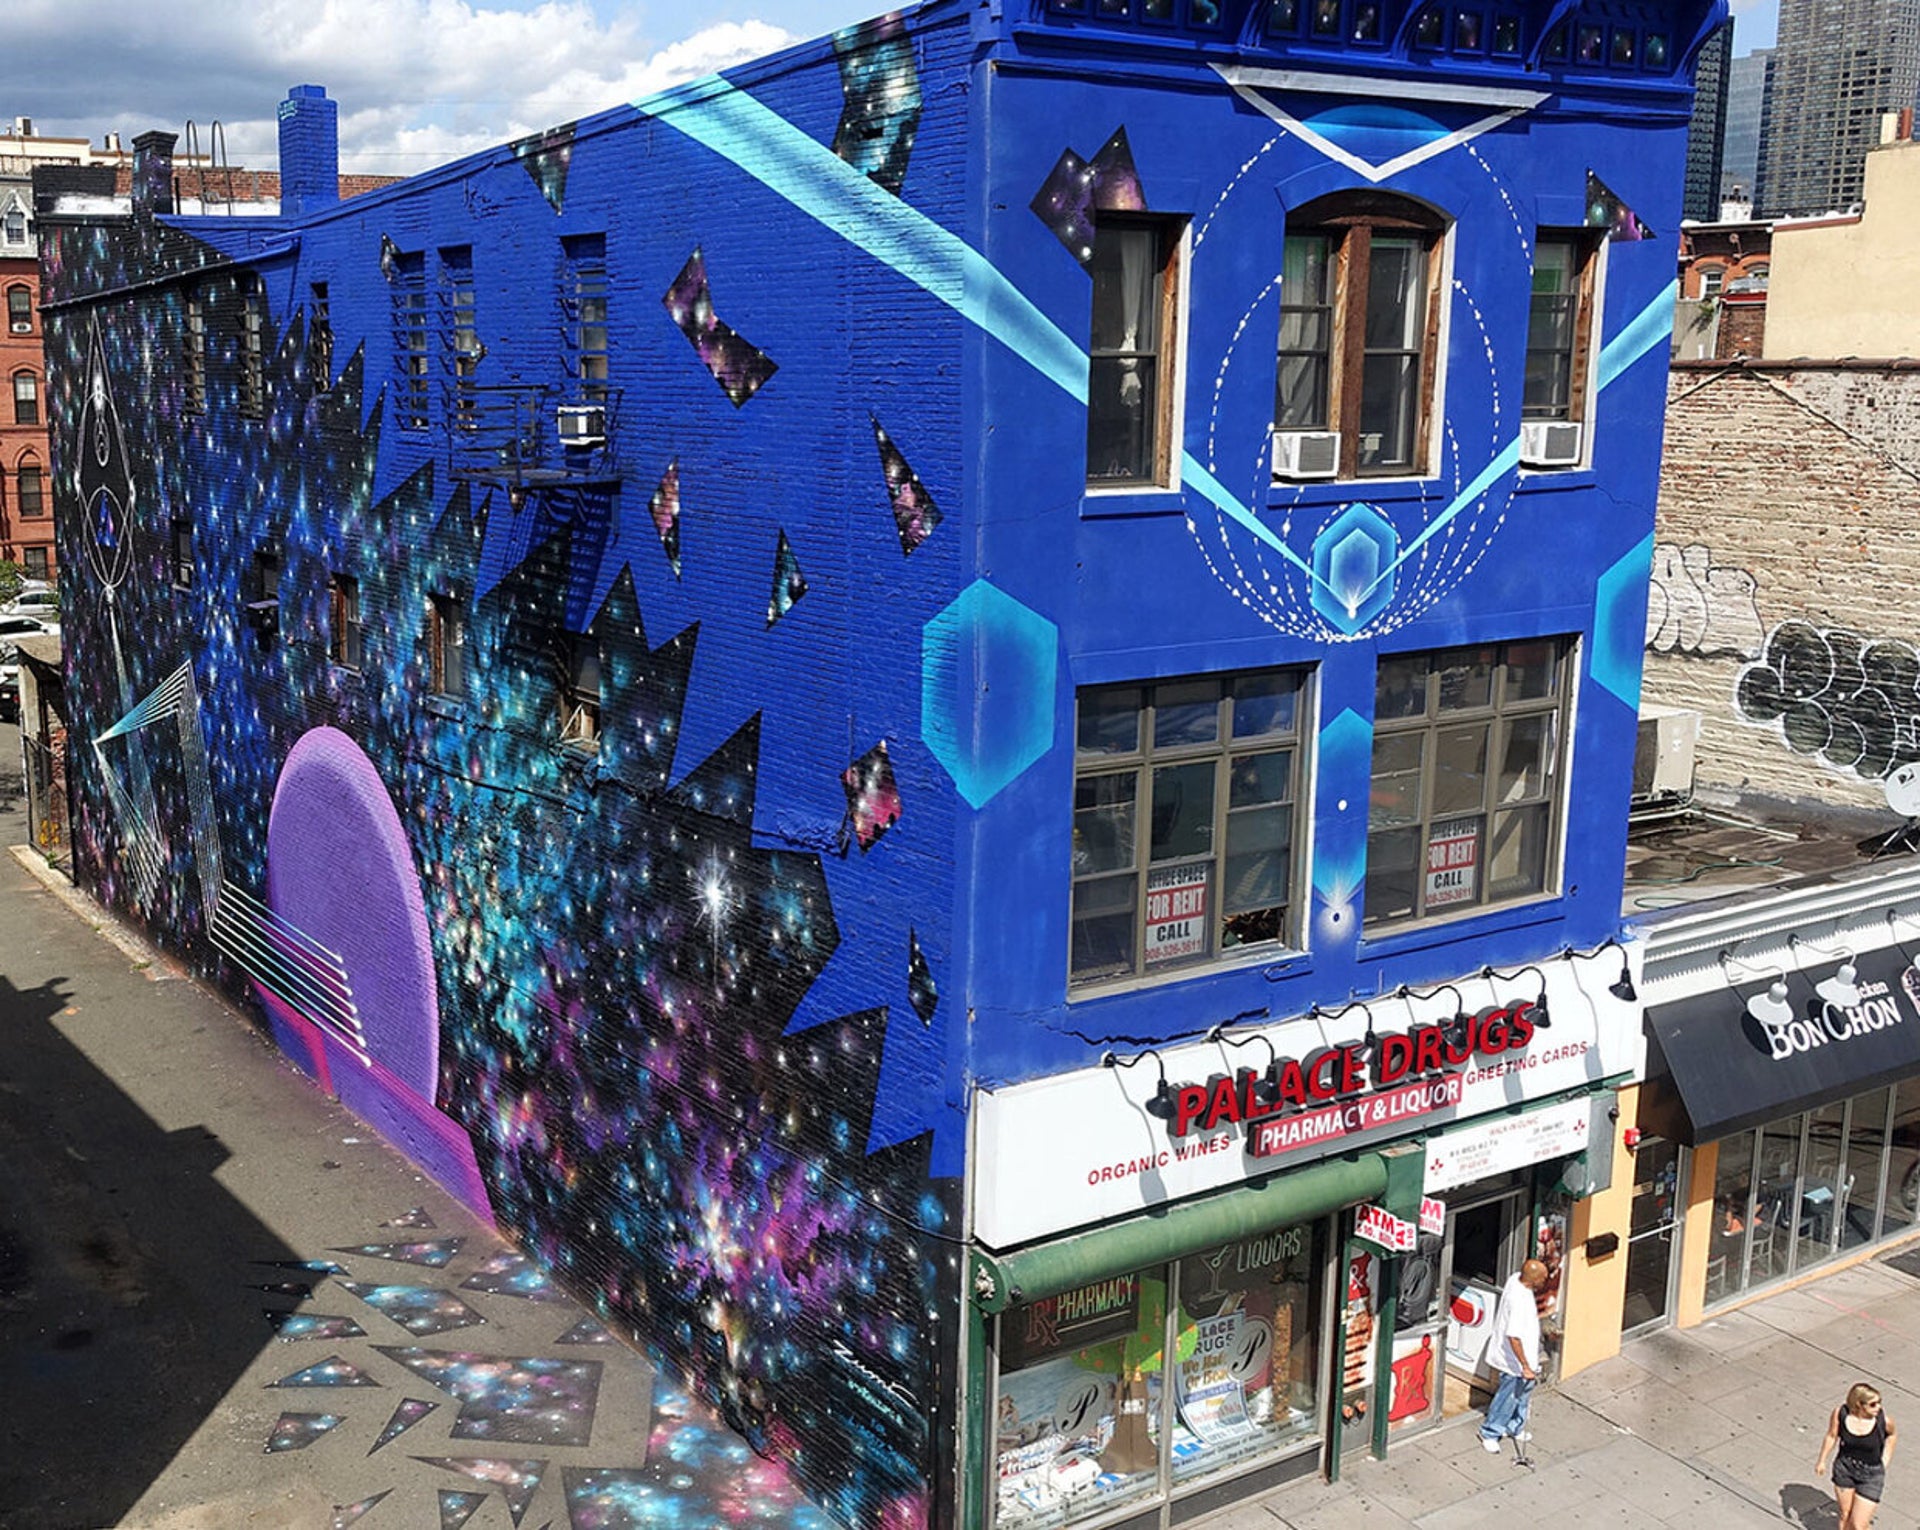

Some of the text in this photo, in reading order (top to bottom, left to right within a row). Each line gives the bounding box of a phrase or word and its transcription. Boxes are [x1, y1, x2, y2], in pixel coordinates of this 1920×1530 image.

[1448, 839, 1475, 866] RENT
[1434, 870, 1462, 888] CALL
[1147, 886, 1205, 921] FOR RENT
[1157, 920, 1190, 942] CALL
[1175, 1001, 1535, 1137] PALACE DRUGS
[1466, 1041, 1589, 1085] GREETING CARDS
[1260, 1081, 1460, 1151] PHARMACY & LIQUOR
[1087, 1134, 1231, 1186] ORGANIC WINES
[1359, 1204, 1395, 1235] ATM
[1237, 1228, 1301, 1273] LIQUORS
[1056, 1274, 1134, 1322] PHARMACY
